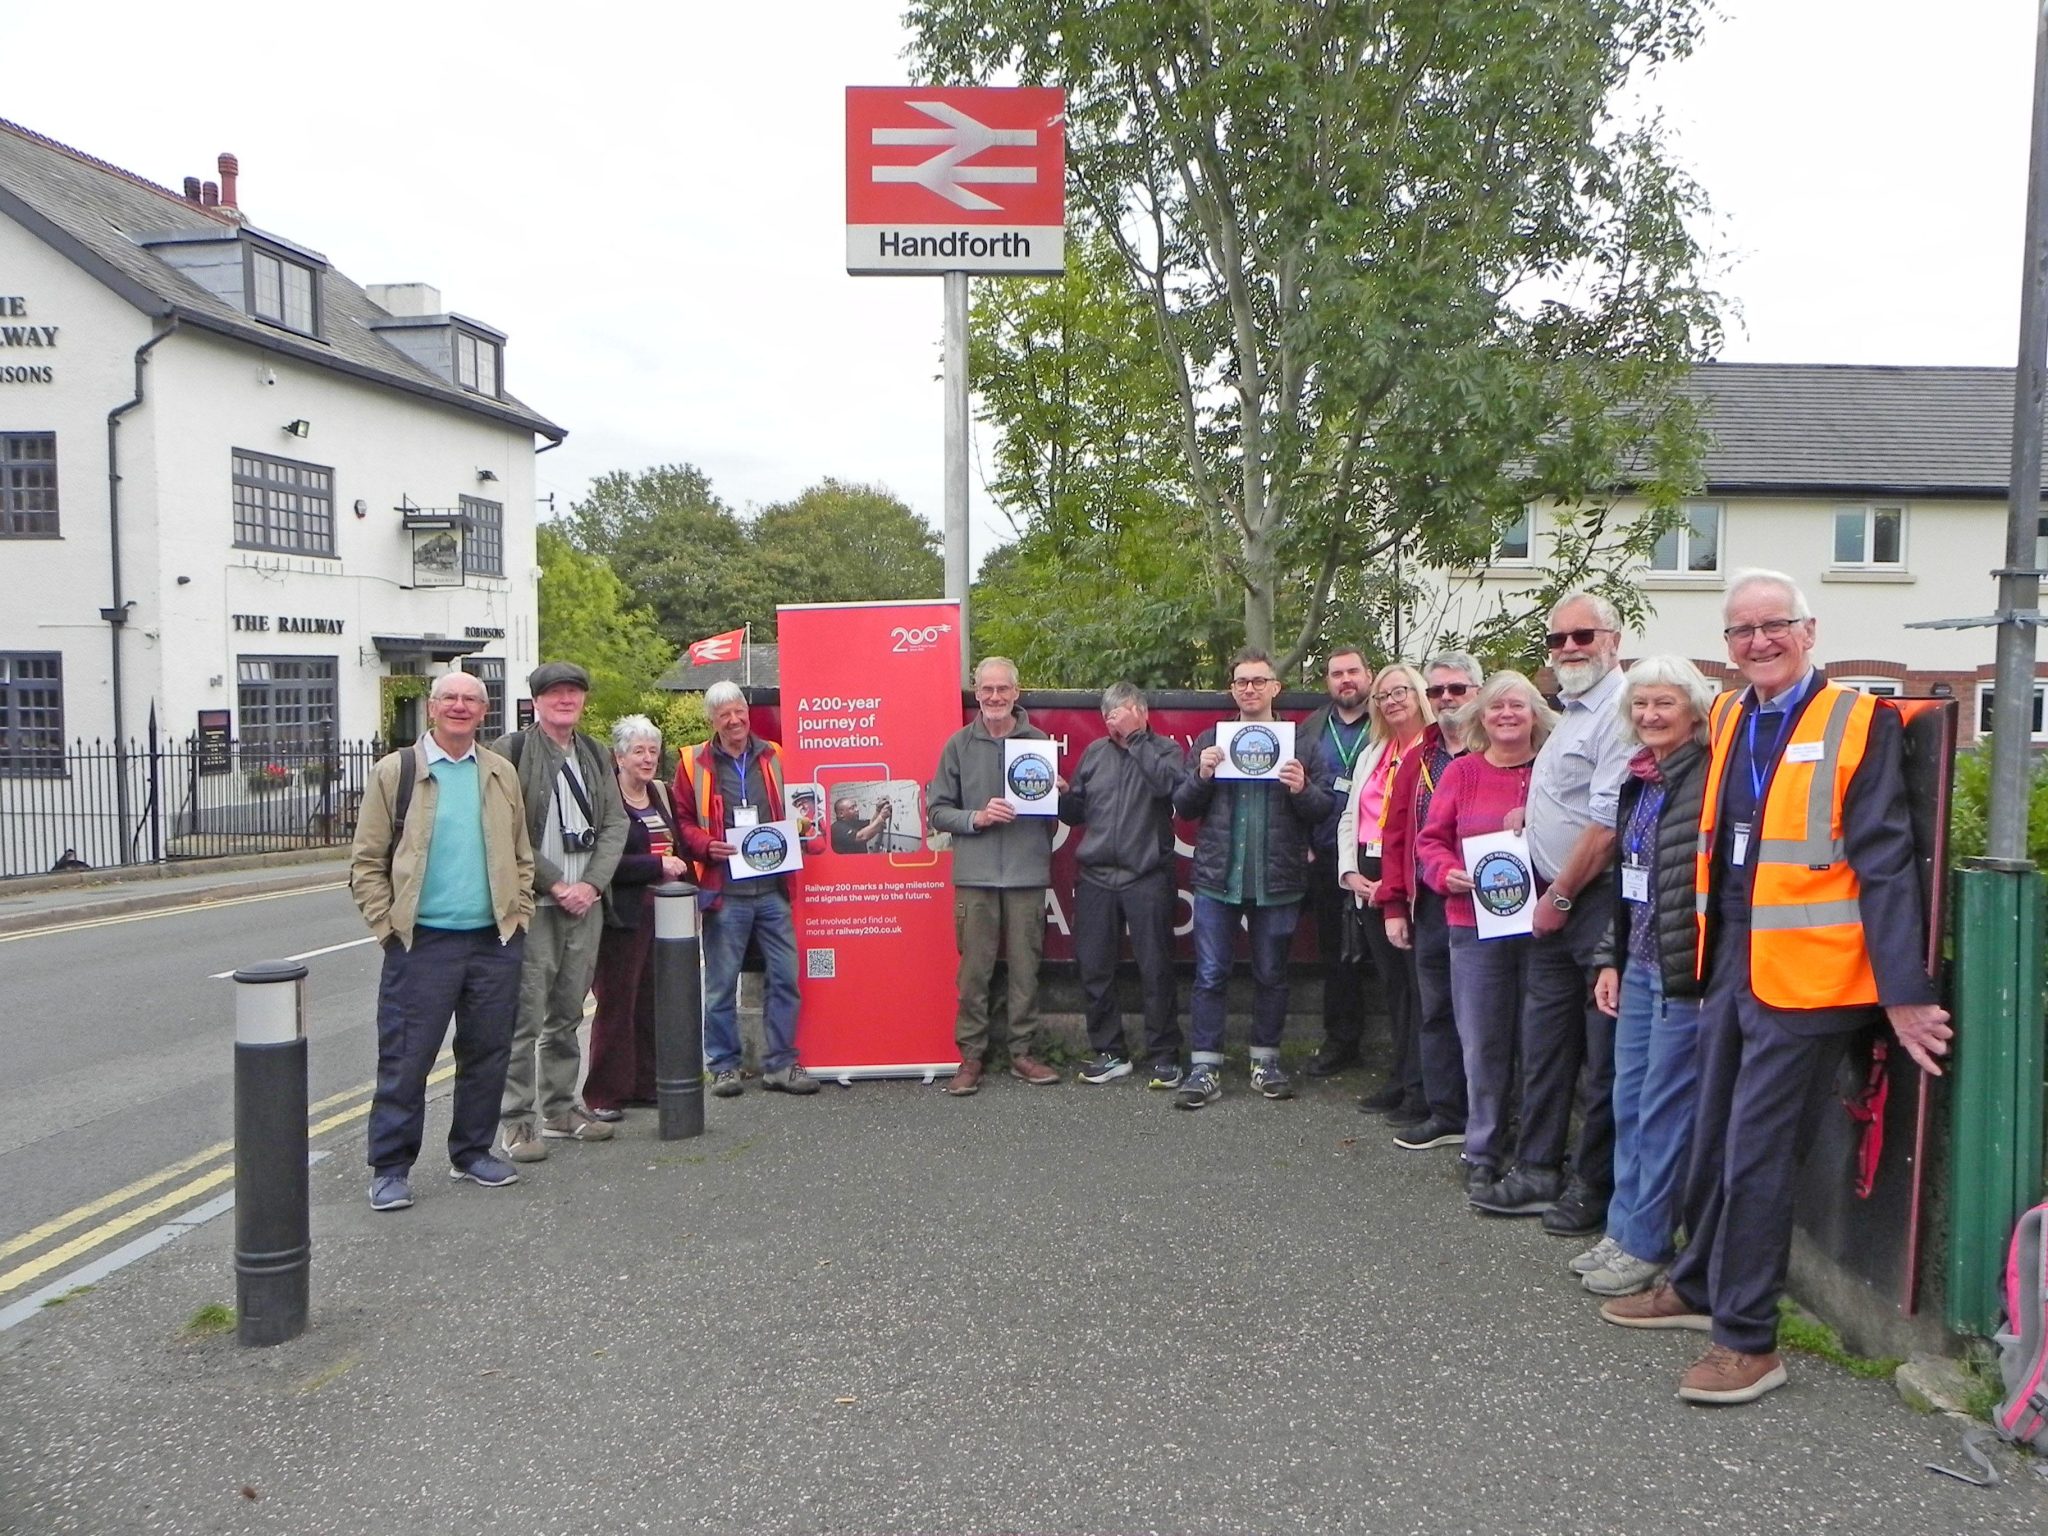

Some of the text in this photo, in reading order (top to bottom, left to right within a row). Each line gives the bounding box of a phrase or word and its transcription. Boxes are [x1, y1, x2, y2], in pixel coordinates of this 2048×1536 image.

[880, 232, 1030, 257] Handforth
[0, 326, 59, 347] WAY
[232, 614, 345, 635] THE RAILWAY
[464, 626, 506, 639] ROBINSONS
[891, 626, 940, 652] 200
[798, 697, 882, 712] A 200-year
[797, 714, 876, 733] journey of
[800, 734, 883, 749] innovation.
[1495, 852, 1526, 873] MANCHESTER
[804, 884, 835, 893] Railway
[835, 883, 851, 891] 200
[884, 882, 904, 891] huge
[905, 881, 945, 889] milestone
[820, 894, 848, 903] signals
[863, 894, 881, 902] way
[890, 892, 904, 900] the
[806, 918, 819, 926] Get
[820, 917, 851, 925] involved
[852, 916, 867, 924] and
[868, 916, 883, 924] find
[835, 926, 902, 937] railway200.co.uk
